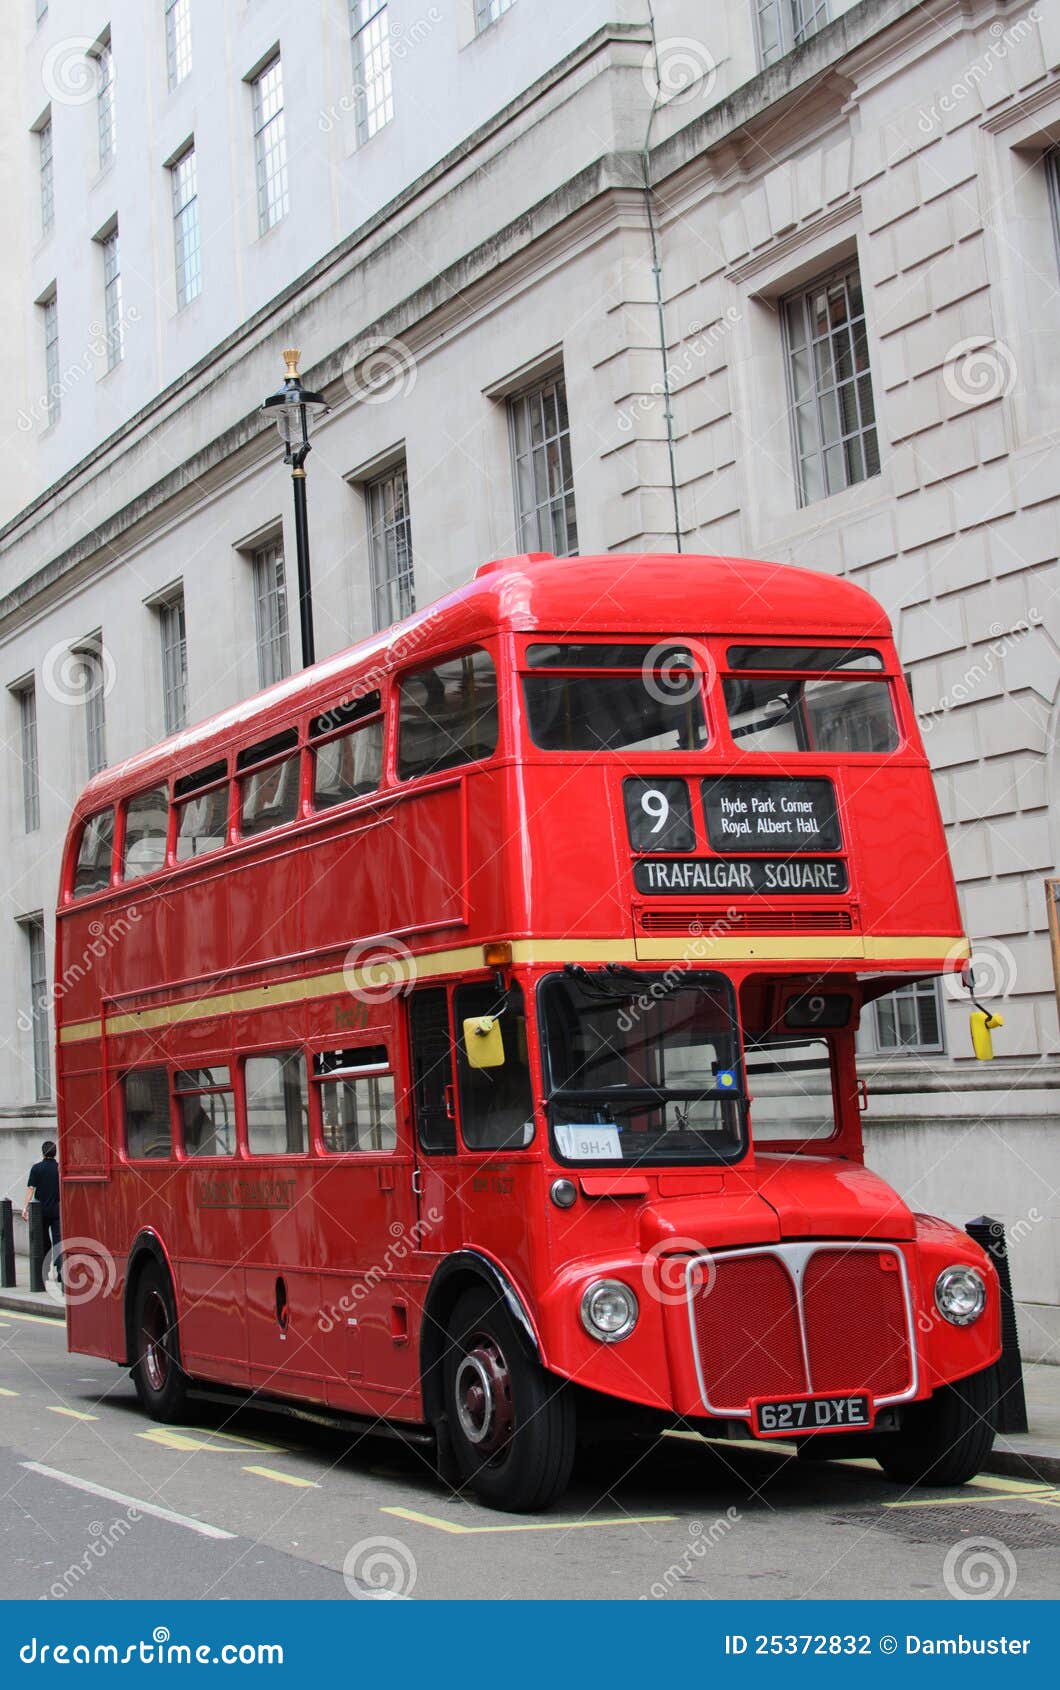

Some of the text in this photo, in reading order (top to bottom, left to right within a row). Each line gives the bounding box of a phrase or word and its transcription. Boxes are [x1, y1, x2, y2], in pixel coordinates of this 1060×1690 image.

[641, 790, 669, 833] 9
[721, 798, 813, 817] Hyde Park Corner
[721, 818, 820, 837] Royal Albert Hall
[644, 863, 839, 888] TRAFALGAR SQUARE
[808, 996, 825, 1022] 9
[580, 1141, 612, 1154] 9H-1
[761, 1399, 864, 1429] 627 DYE
